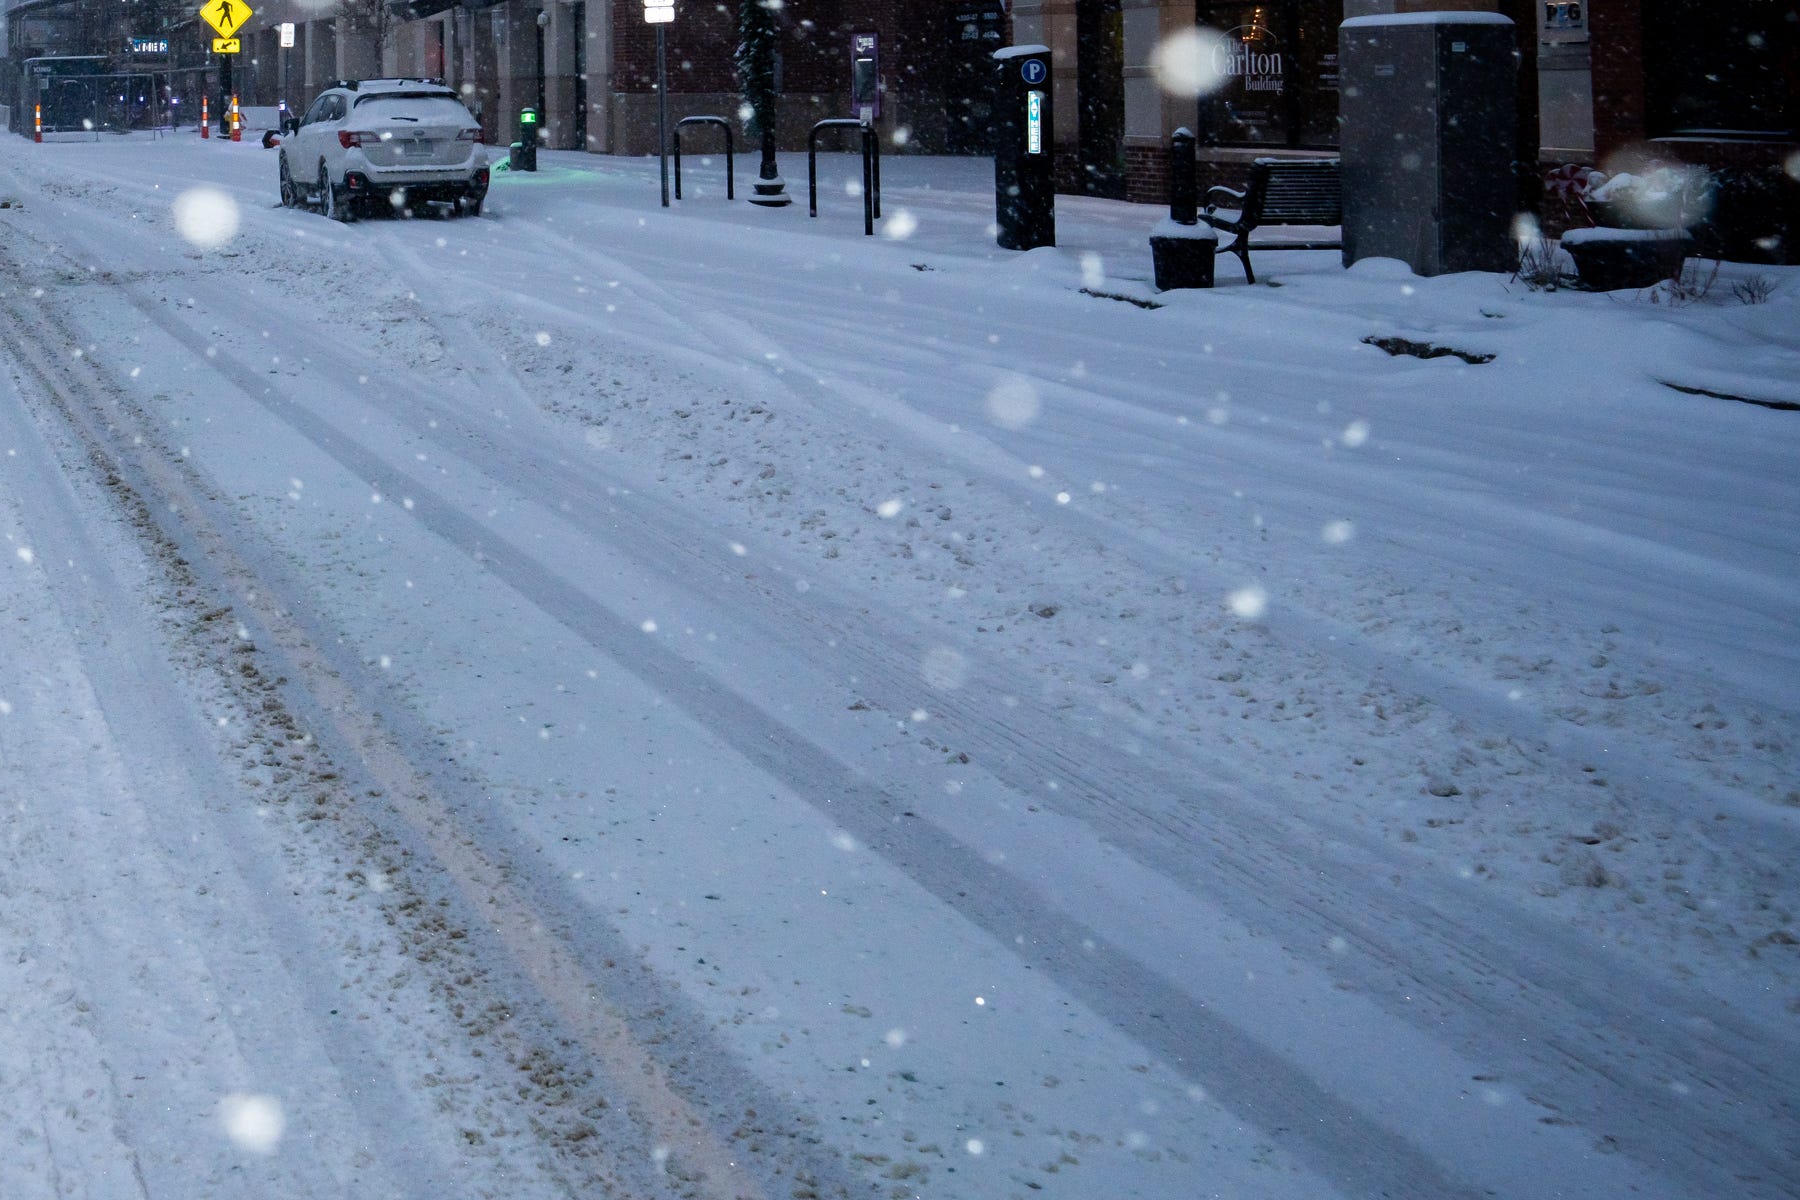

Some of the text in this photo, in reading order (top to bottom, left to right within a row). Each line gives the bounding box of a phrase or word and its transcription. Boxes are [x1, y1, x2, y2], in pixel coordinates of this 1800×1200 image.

[1212, 44, 1283, 75] Carlton
[1029, 63, 1041, 80] P
[1245, 75, 1284, 96] Building
